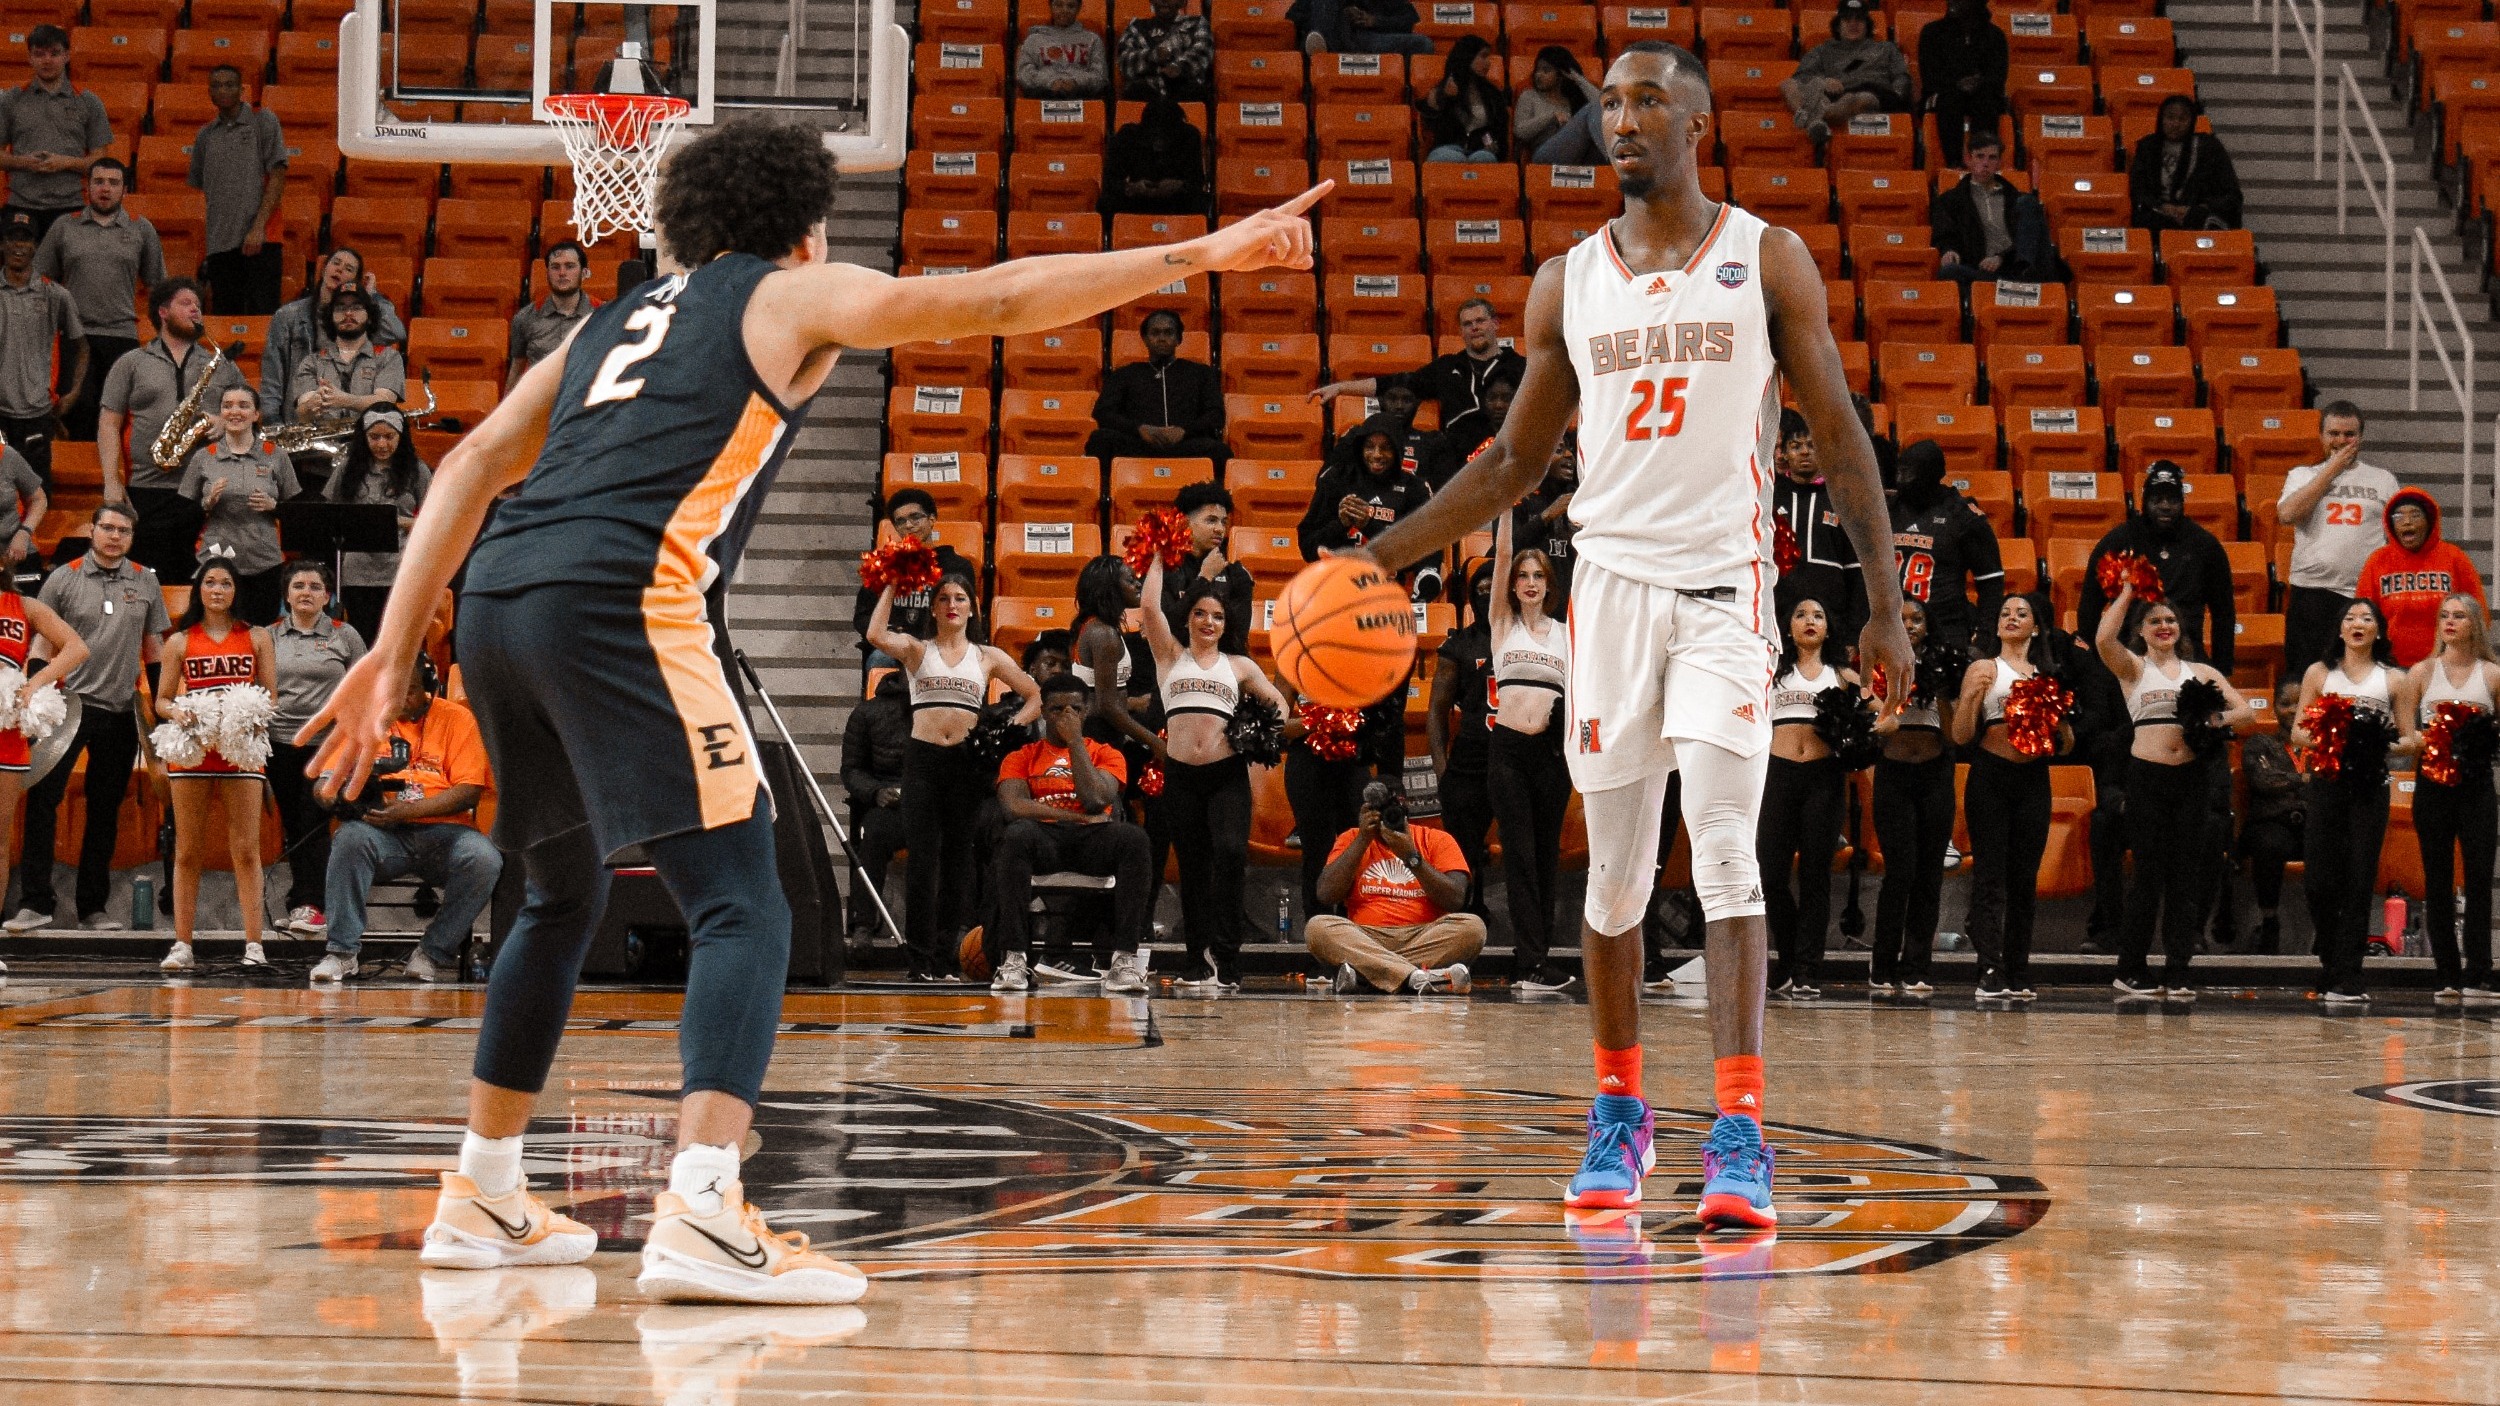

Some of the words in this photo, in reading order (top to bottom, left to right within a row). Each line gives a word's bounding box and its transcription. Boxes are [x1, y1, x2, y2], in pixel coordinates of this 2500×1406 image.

[375, 125, 427, 139] SPALDING
[583, 303, 677, 408] 2
[1589, 322, 1734, 376] BEARS
[1625, 377, 1689, 442] 25
[2325, 502, 2363, 526] 23
[2380, 571, 2452, 597] MERCER
[185, 654, 254, 681] BEARS
[697, 721, 746, 771] E
[1361, 884, 1391, 895] MERCER
